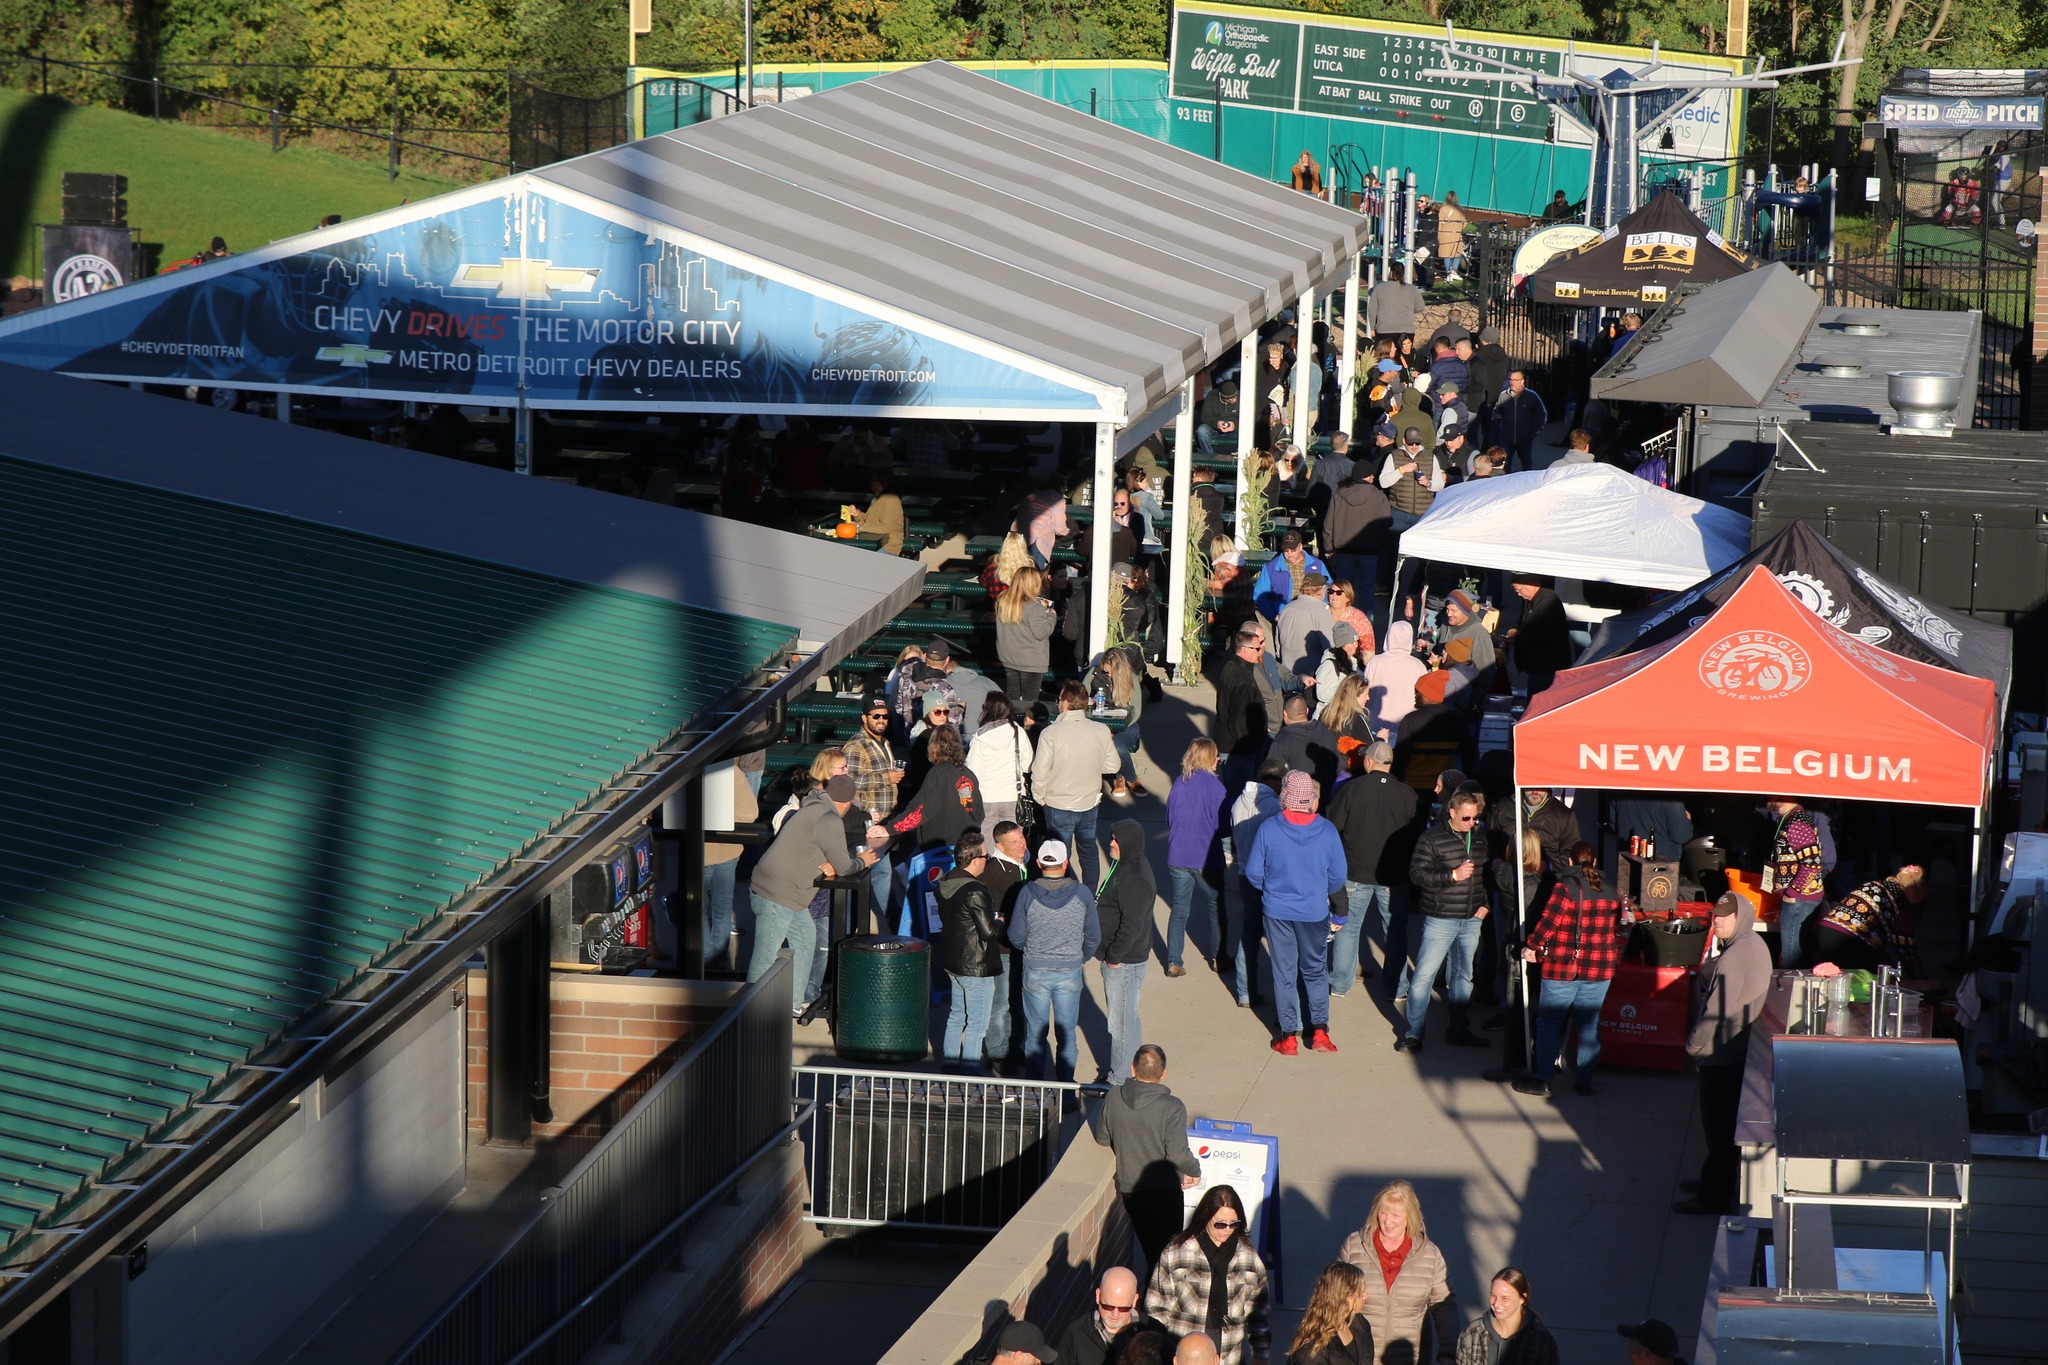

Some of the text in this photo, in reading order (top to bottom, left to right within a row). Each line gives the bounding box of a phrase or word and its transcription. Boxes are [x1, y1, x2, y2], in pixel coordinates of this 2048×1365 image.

[1225, 23, 1257, 34] Michigan
[1225, 31, 1269, 42] Orthopaedic
[1225, 39, 1257, 50] Surgeons
[1383, 36, 1388, 46] 1
[1394, 38, 1401, 48] 2
[1406, 39, 1413, 49] 3
[1418, 40, 1425, 50] 4
[1477, 47, 1484, 57] 9
[1486, 48, 1498, 58] 10
[1513, 50, 1520, 61] R
[1526, 52, 1534, 62] H
[1540, 53, 1546, 64] E
[1191, 47, 1280, 81] Wiffle Ball
[1314, 44, 1339, 56] EAST
[1343, 47, 1366, 59] SIDE
[1382, 52, 1387, 62] 1
[1393, 53, 1400, 63] 0
[1404, 54, 1412, 64] 0
[1418, 56, 1422, 66] 1
[1430, 57, 1434, 67] 1
[1452, 60, 1459, 70] 0
[1464, 61, 1470, 71] 2
[1476, 62, 1482, 72] 0
[1314, 59, 1343, 72] UTICA
[1380, 67, 1386, 77] 0
[1392, 68, 1398, 78] 0
[1405, 70, 1409, 80] 1
[1415, 71, 1422, 81] 0
[651, 84, 665, 96] 82
[1220, 78, 1250, 100] PARK
[1332, 87, 1351, 98] BAT
[1358, 90, 1382, 102] BALL
[1389, 94, 1422, 106] STRIKE
[1430, 98, 1451, 110] OUT
[1177, 107, 1214, 123] 93 FEET
[1884, 104, 2039, 122] SPEED USPBL PITCH
[1632, 234, 1694, 248] BELL'S
[72, 273, 102, 300] 42
[1583, 288, 1609, 296] Inspired
[314, 305, 742, 346] CHEVY DRIVES THE MOTOR CITY
[121, 340, 244, 358] #CHEVYDETROITFAN
[400, 350, 742, 380] METRO DETROIT CHEVY DEALERS
[812, 368, 936, 383] CHEVYDETROIT.COM
[1704, 634, 1806, 671] NEW BELGIUM
[1716, 688, 1788, 700] BREWING
[1580, 743, 1685, 772] NEW
[1620, 1022, 1658, 1031] BELGIUM
[1213, 1150, 1241, 1160] pepsi
